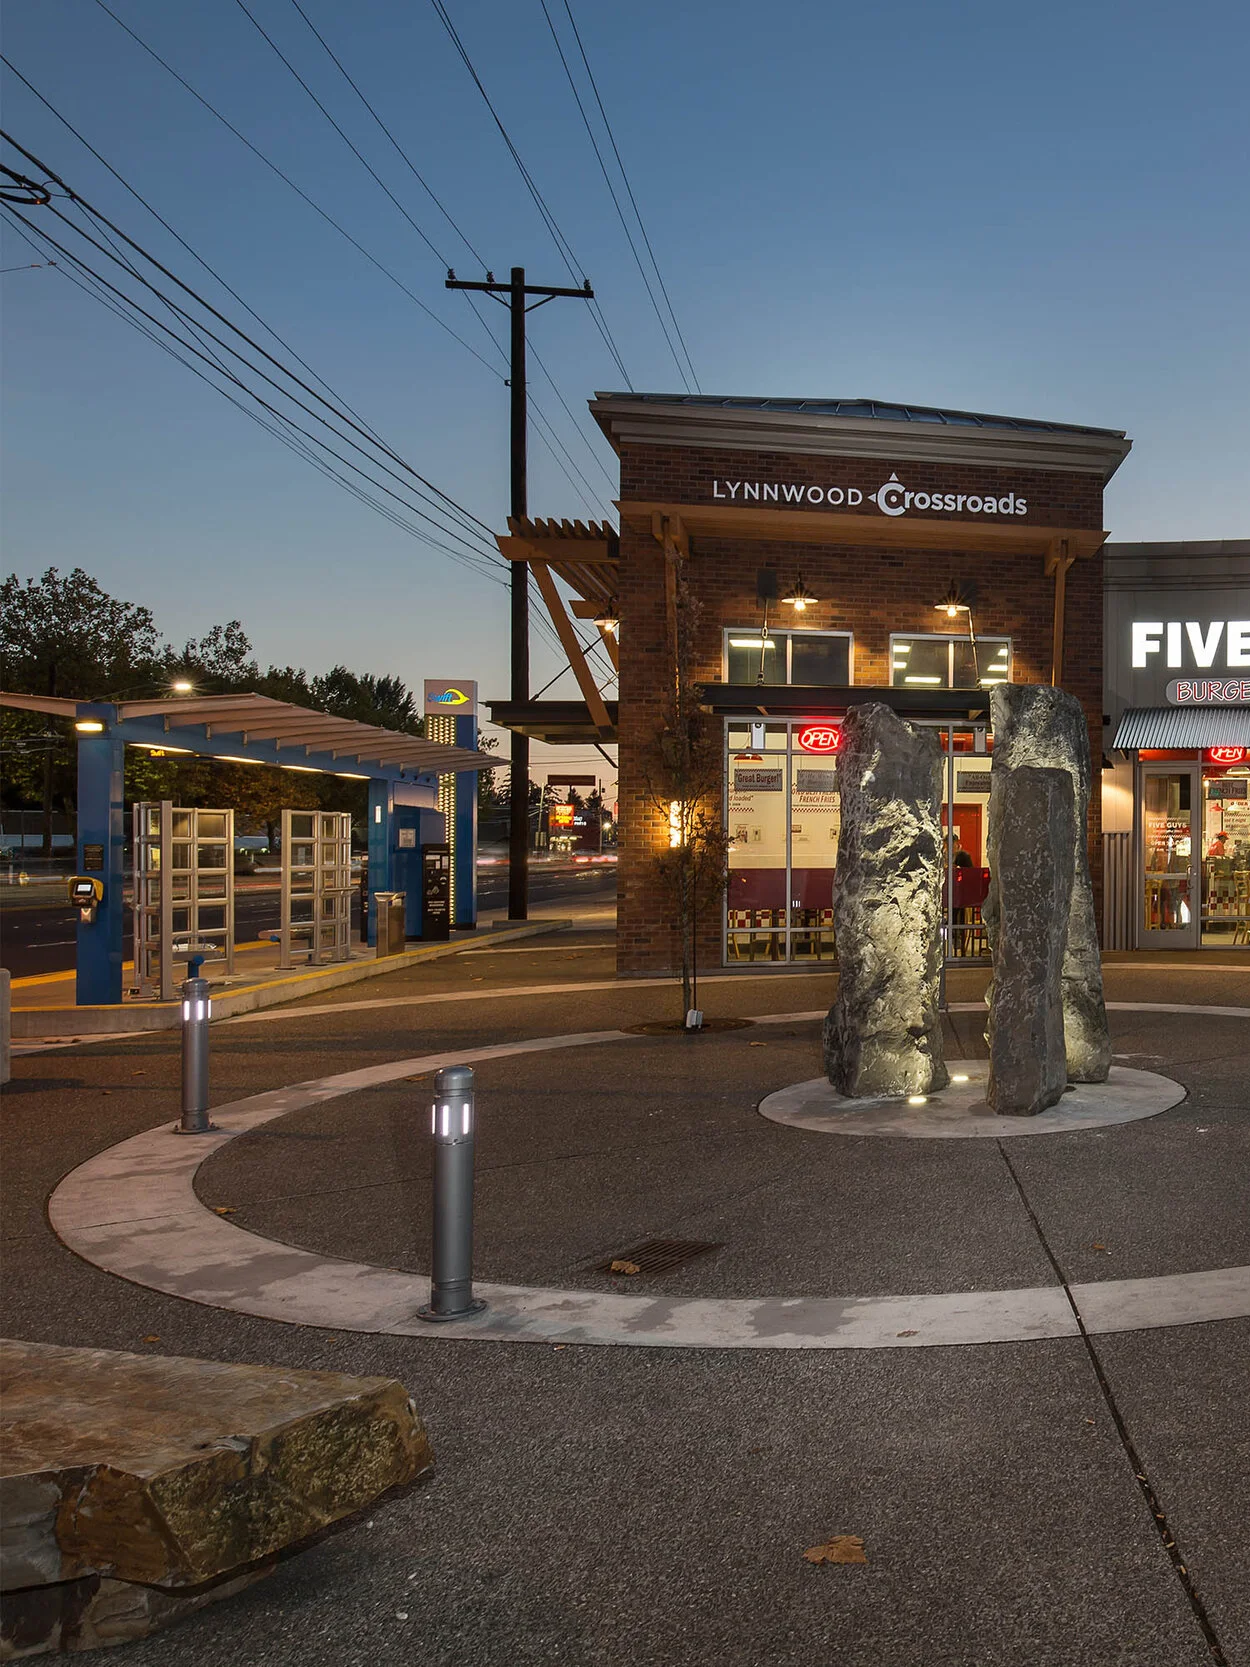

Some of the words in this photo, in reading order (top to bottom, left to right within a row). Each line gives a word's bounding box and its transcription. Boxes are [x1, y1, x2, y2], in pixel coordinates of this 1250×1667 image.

[713, 480, 863, 506] LYNNWOOD
[877, 482, 1028, 516] Crossroads
[801, 732, 839, 746] OPEN
[1211, 748, 1243, 758] OPEN
